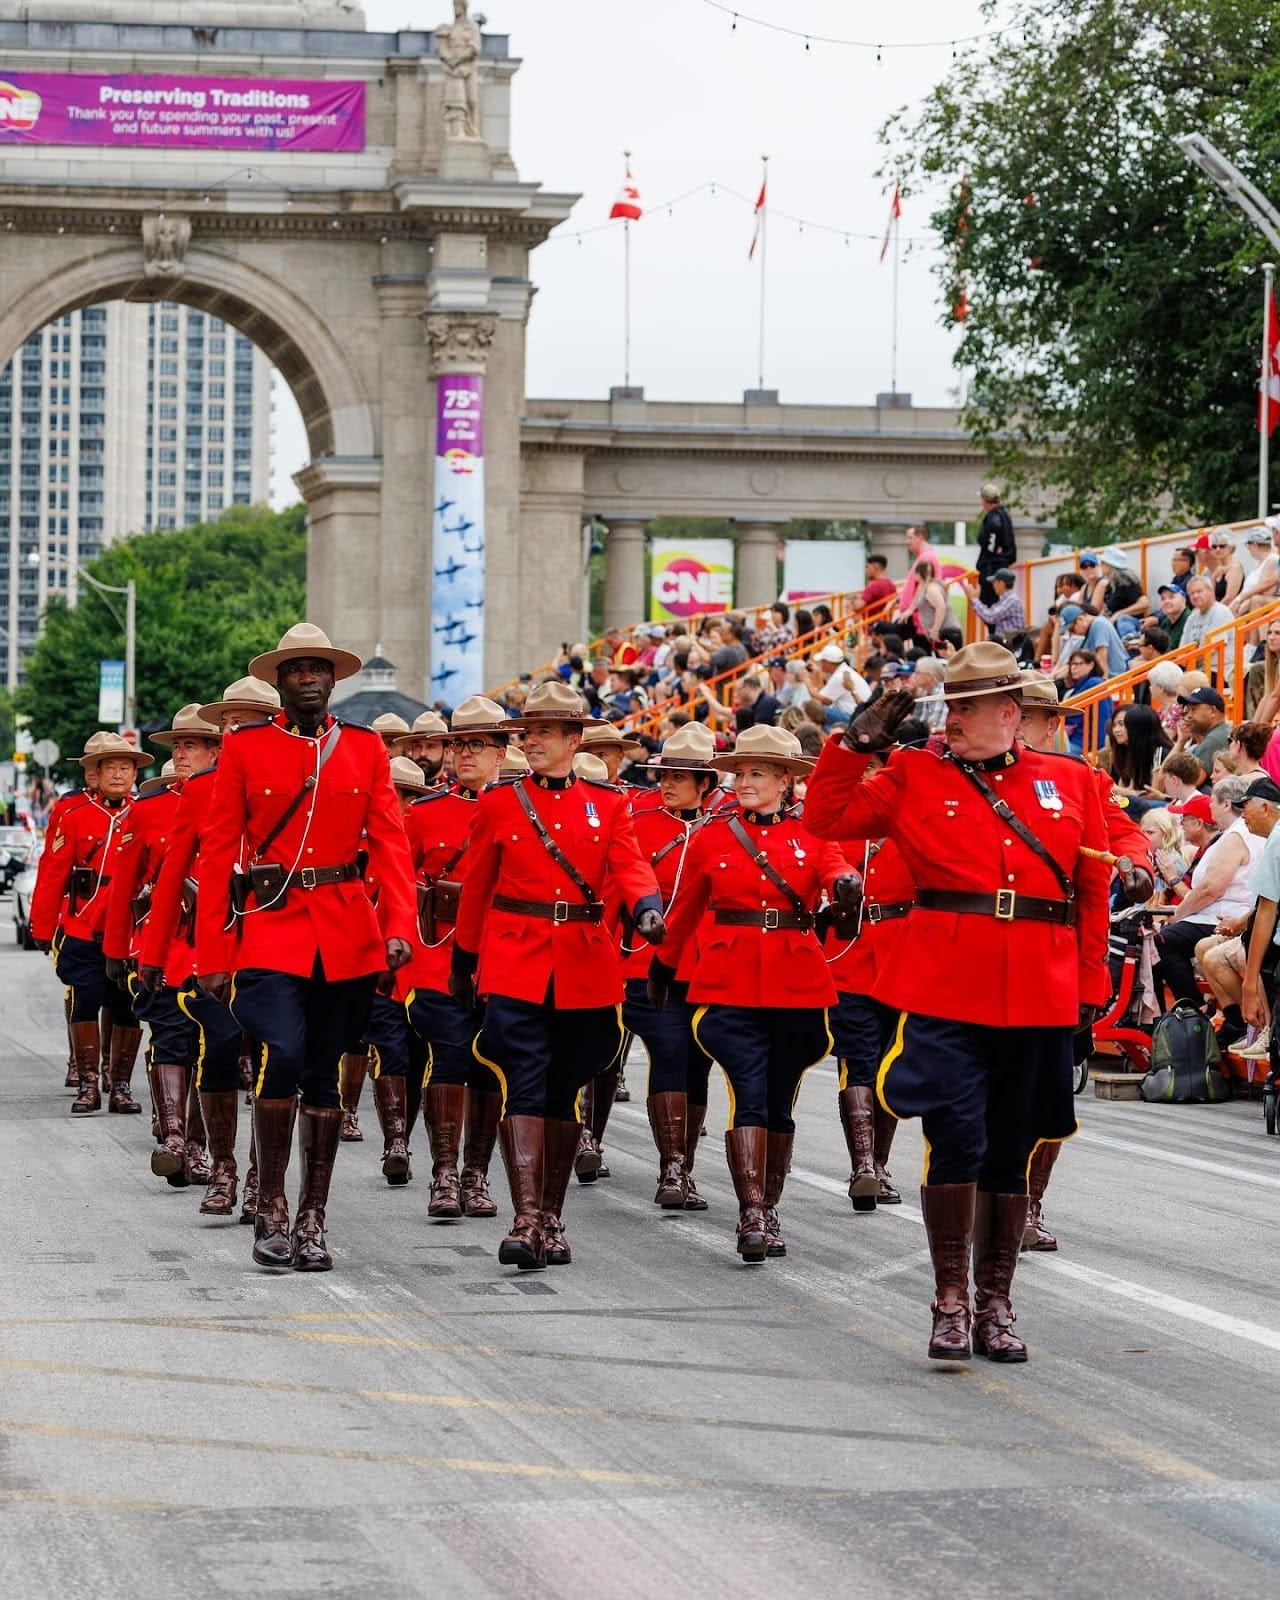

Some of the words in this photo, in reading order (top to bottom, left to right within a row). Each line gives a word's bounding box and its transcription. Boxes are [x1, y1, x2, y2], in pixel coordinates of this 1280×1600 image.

[100, 86, 206, 108] Preserving
[210, 89, 309, 108] Traditions
[67, 106, 106, 119] Thank
[109, 109, 134, 121] you
[137, 108, 155, 120] for
[159, 109, 219, 124] spending
[221, 112, 251, 124] your
[288, 114, 337, 126] present
[112, 121, 138, 134] and
[141, 122, 180, 135] future
[183, 124, 242, 137] summers
[244, 125, 274, 137] with
[275, 127, 295, 138] us!
[444, 389, 478, 408] 75
[652, 571, 733, 604] CNE
